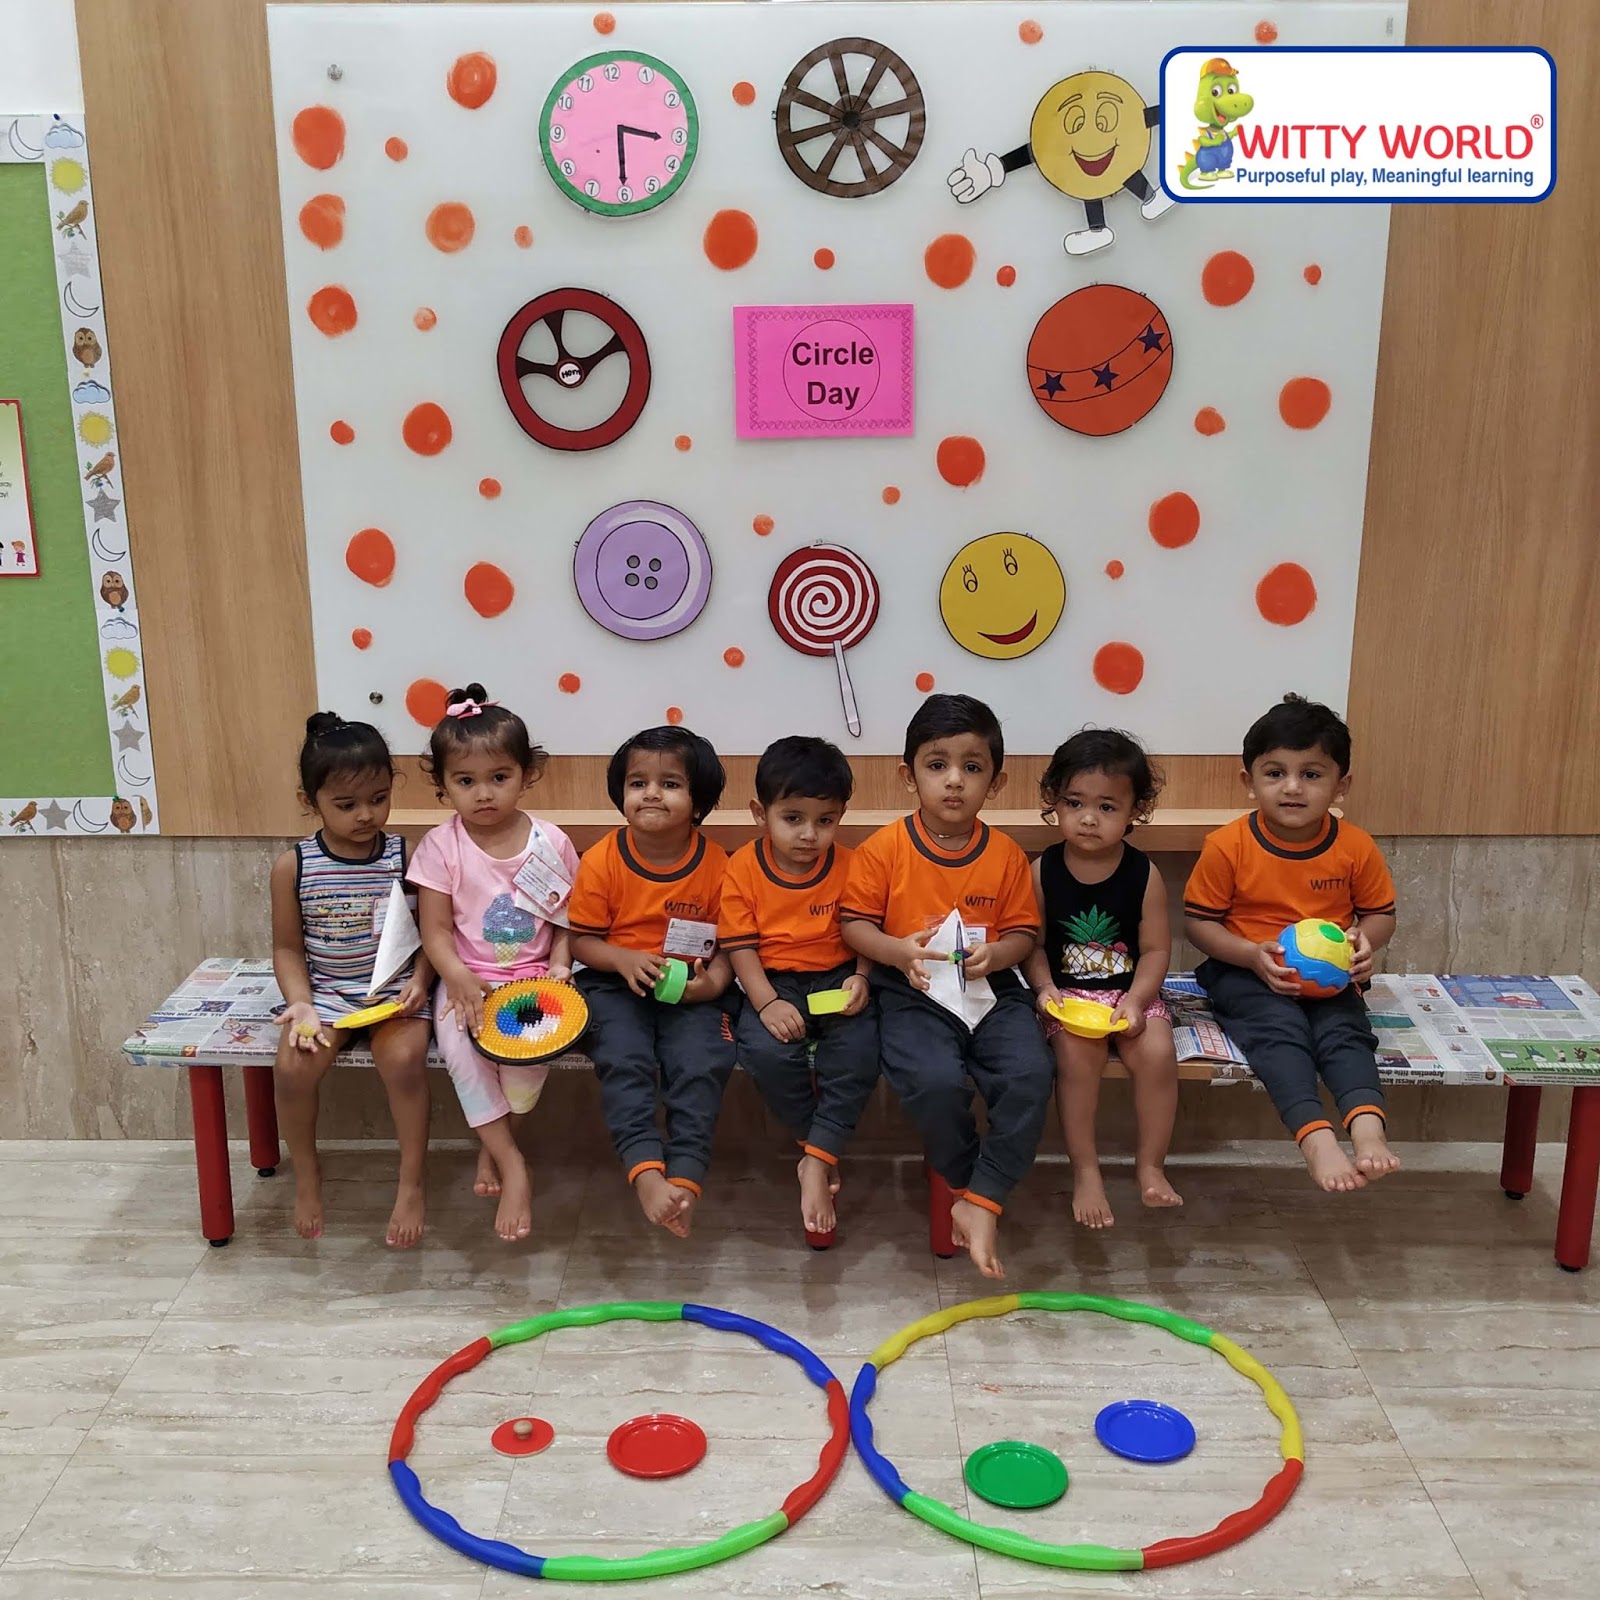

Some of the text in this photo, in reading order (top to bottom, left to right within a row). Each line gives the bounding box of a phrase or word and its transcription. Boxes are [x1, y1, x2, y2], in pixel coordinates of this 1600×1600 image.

[605, 67, 619, 80] 12
[643, 69, 648, 81] 1
[579, 77, 591, 90] 11
[559, 96, 573, 109] 10
[669, 93, 676, 106] 2
[554, 126, 561, 139] 9
[675, 131, 683, 144] 3
[564, 161, 573, 175] 8
[668, 158, 676, 171] 4
[588, 182, 595, 195] 7
[648, 179, 656, 192] 5
[621, 188, 629, 201] 6
[792, 341, 875, 366] Circle
[807, 381, 861, 411] Day
[664, 900, 703, 915] WITTY
